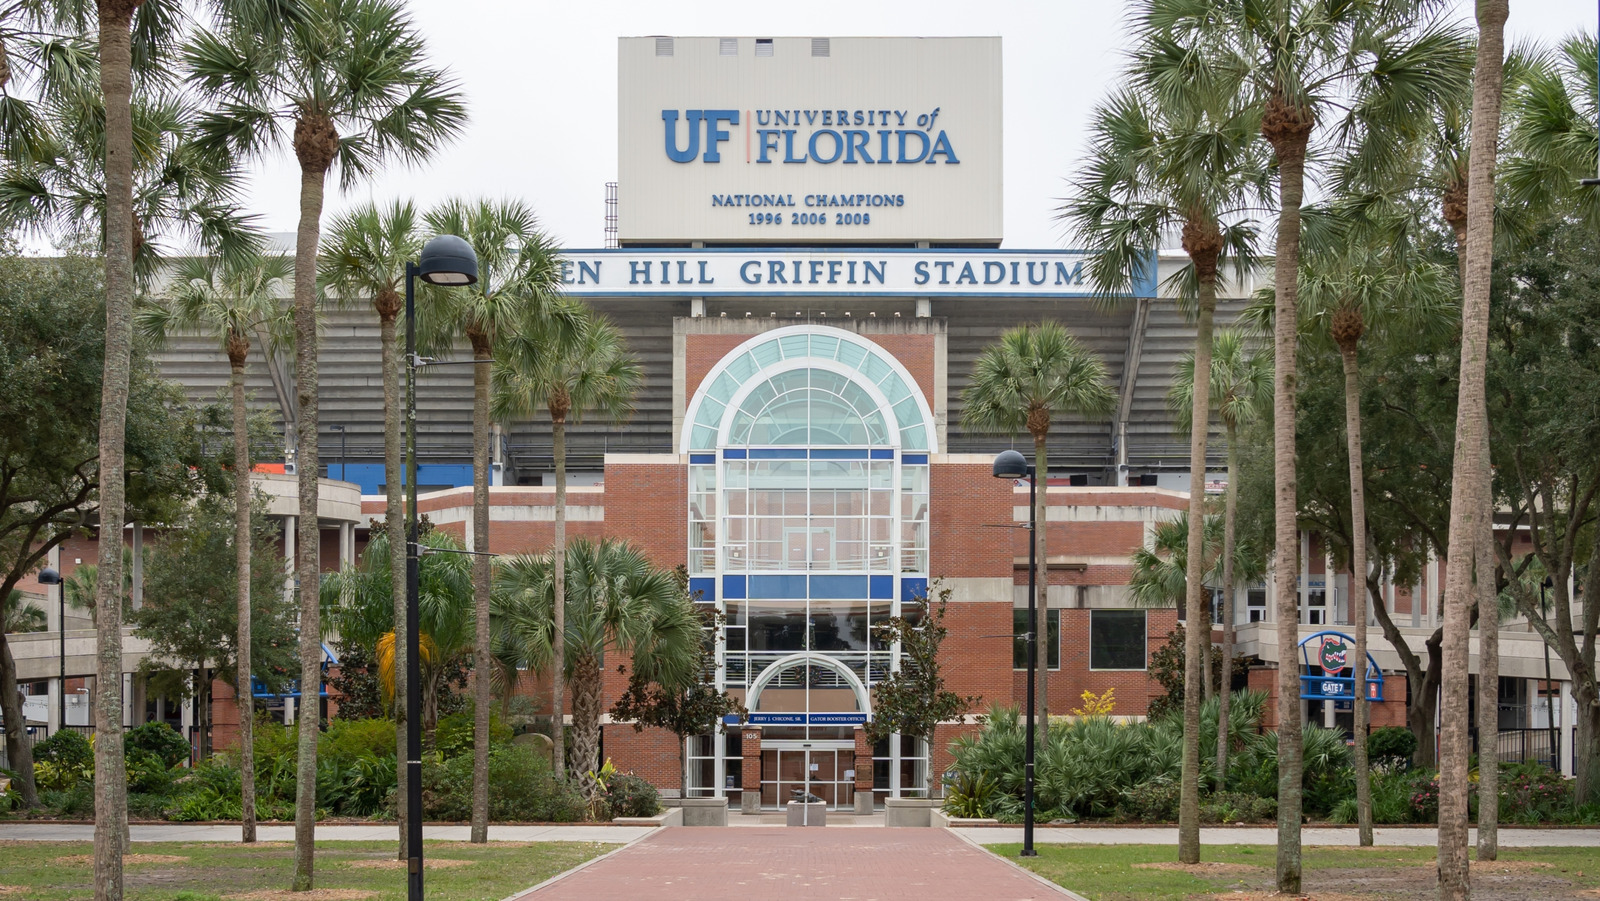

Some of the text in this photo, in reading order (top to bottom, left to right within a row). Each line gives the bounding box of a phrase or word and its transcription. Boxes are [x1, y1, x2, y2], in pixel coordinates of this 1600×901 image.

[756, 107, 941, 132] UNIVERSITY of
[662, 109, 740, 163] UF
[756, 129, 960, 164] FLORIDA
[712, 194, 905, 207] NATIONAL CHAMPIONS
[748, 213, 871, 225] 1996 2006 2008
[558, 260, 1085, 286] EN HILL GRIFFIN STADIUM
[1322, 683, 1344, 692] GATE 7
